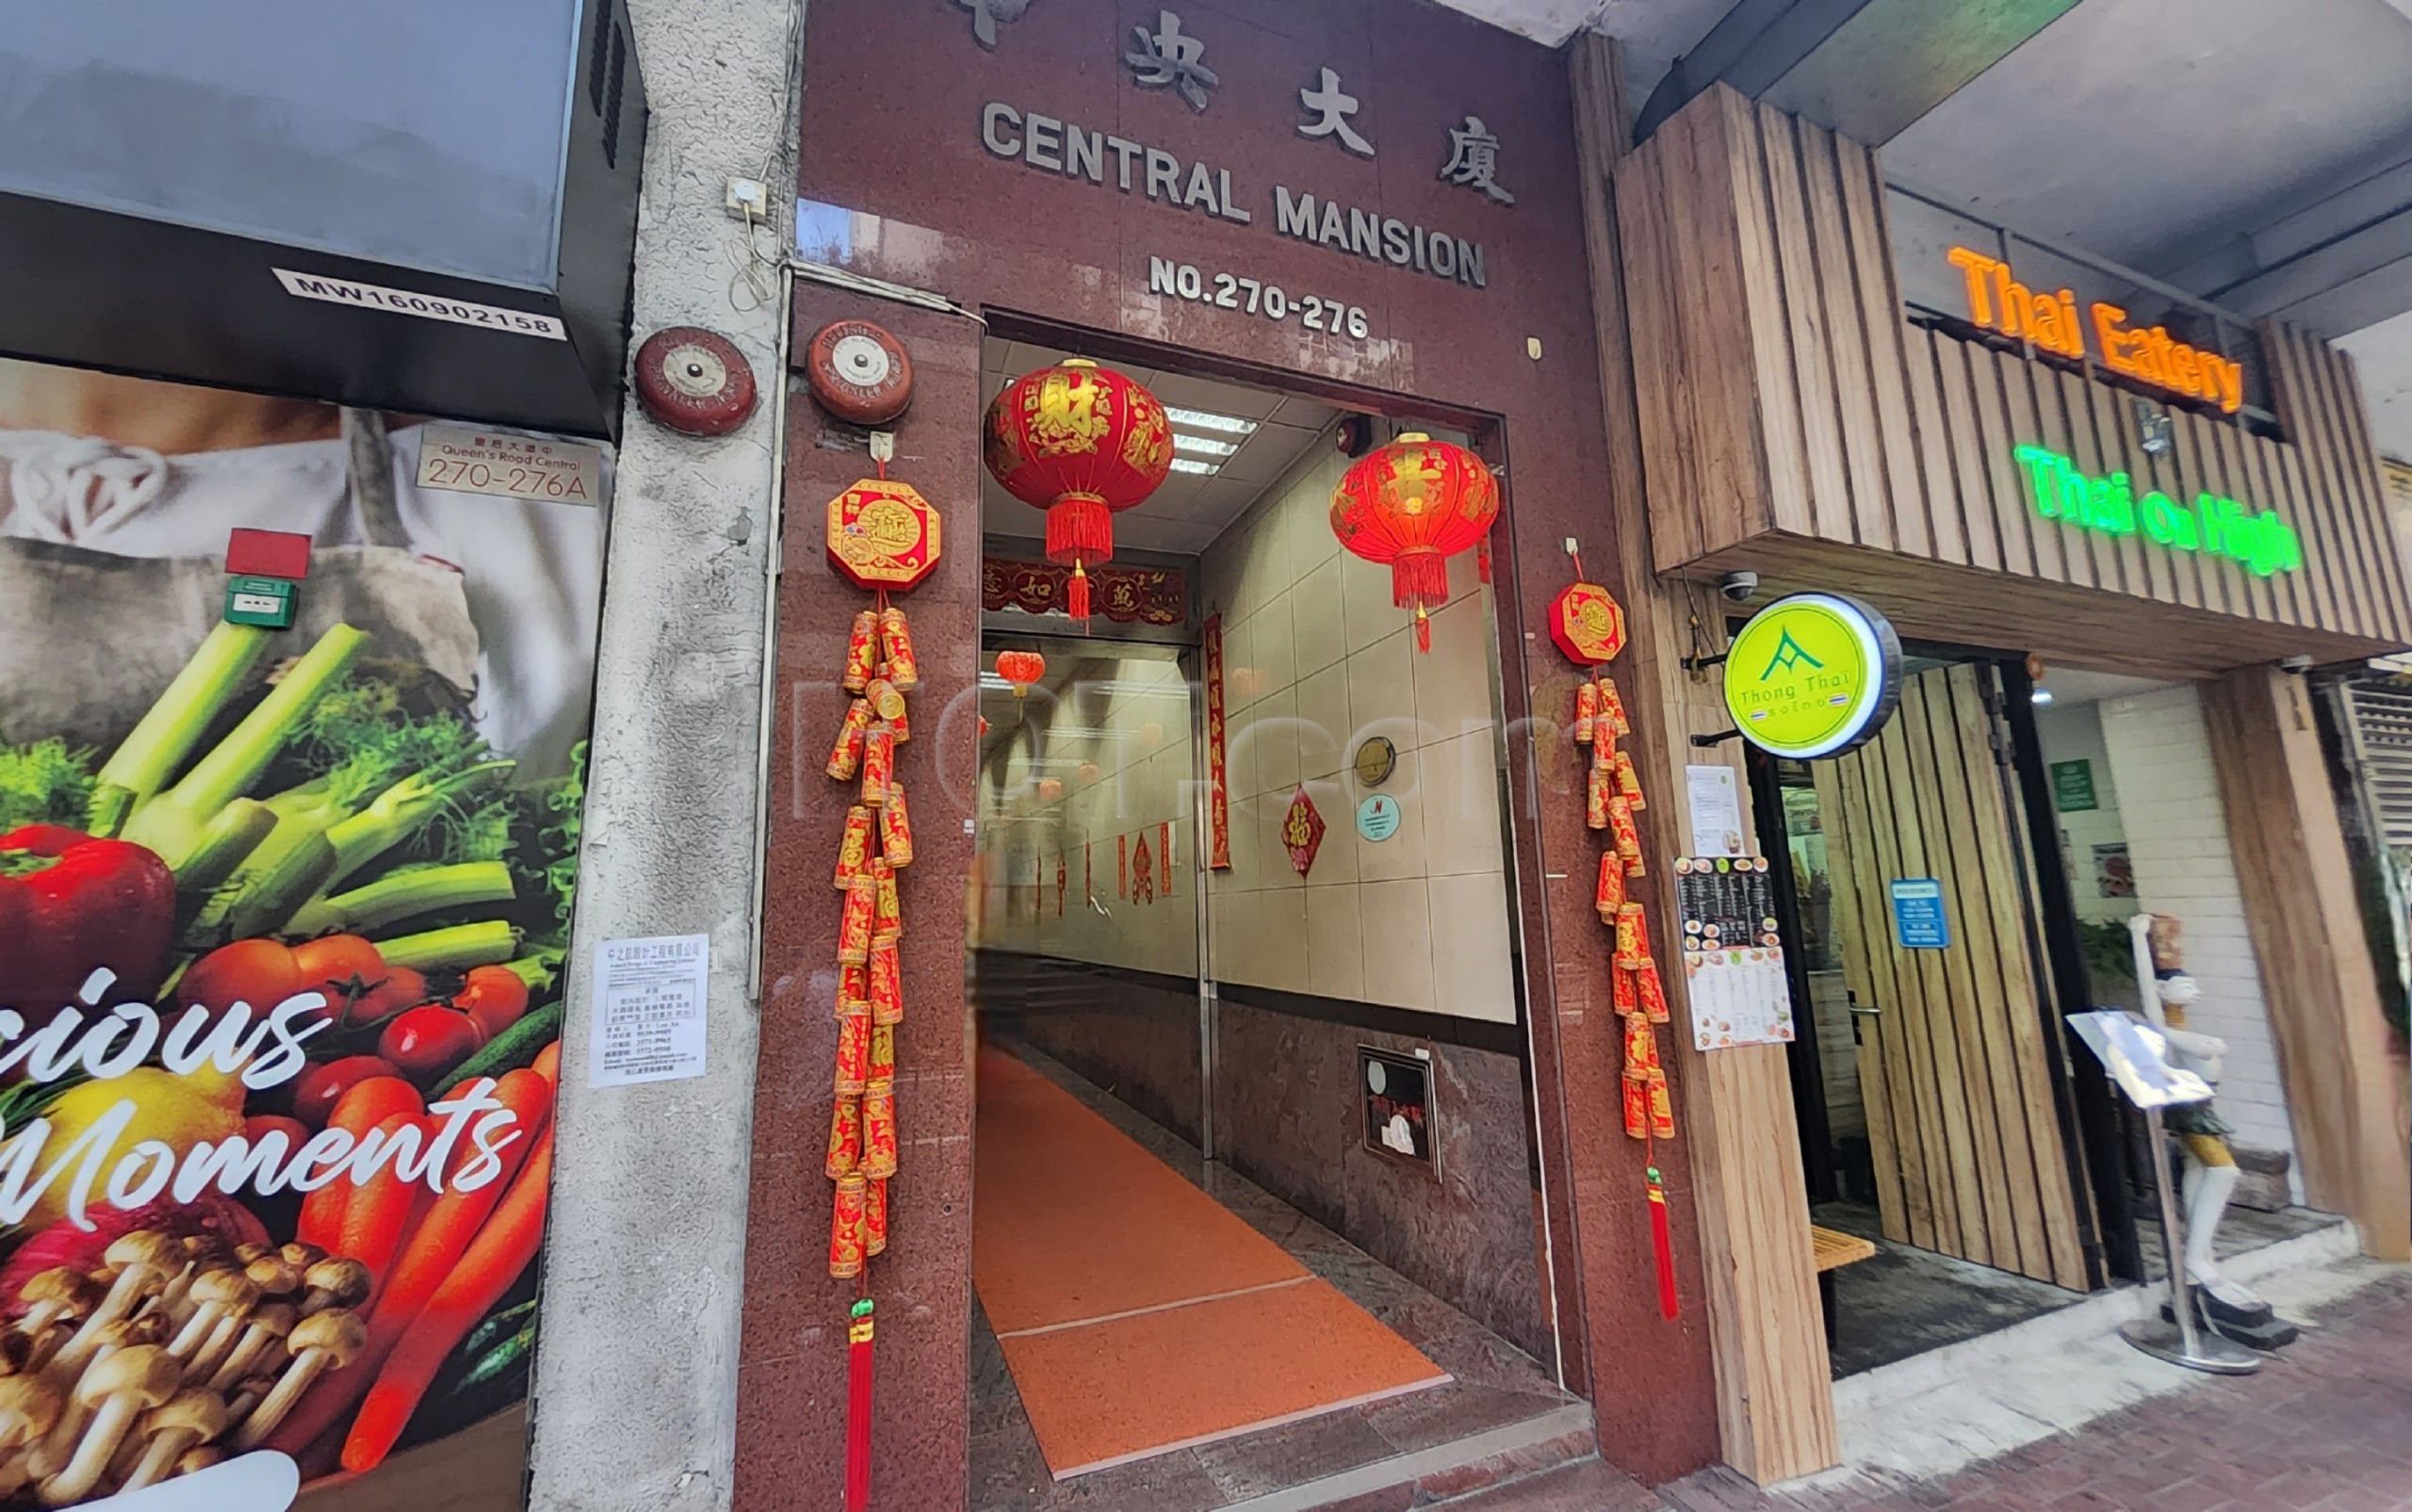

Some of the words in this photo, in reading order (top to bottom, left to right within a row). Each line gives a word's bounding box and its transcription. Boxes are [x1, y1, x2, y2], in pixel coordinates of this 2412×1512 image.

[982, 101, 1250, 223] CENTRAL
[1276, 185, 1486, 285] MANSION
[294, 277, 551, 333] MW160902158
[1149, 255, 1368, 339] NO.270-276
[1948, 246, 2085, 359] Thai
[2091, 301, 2241, 414] Eatery
[429, 458, 587, 499] 270-276A
[442, 444, 496, 460] Queen's
[499, 450, 532, 465] Road
[535, 456, 581, 471] Central
[474, 437, 553, 455] 皇后大道中
[2013, 444, 2136, 535] Thai
[1741, 685, 1796, 705] Thong
[1804, 671, 1850, 693] Thai
[0, 1077, 524, 1233] Moments
